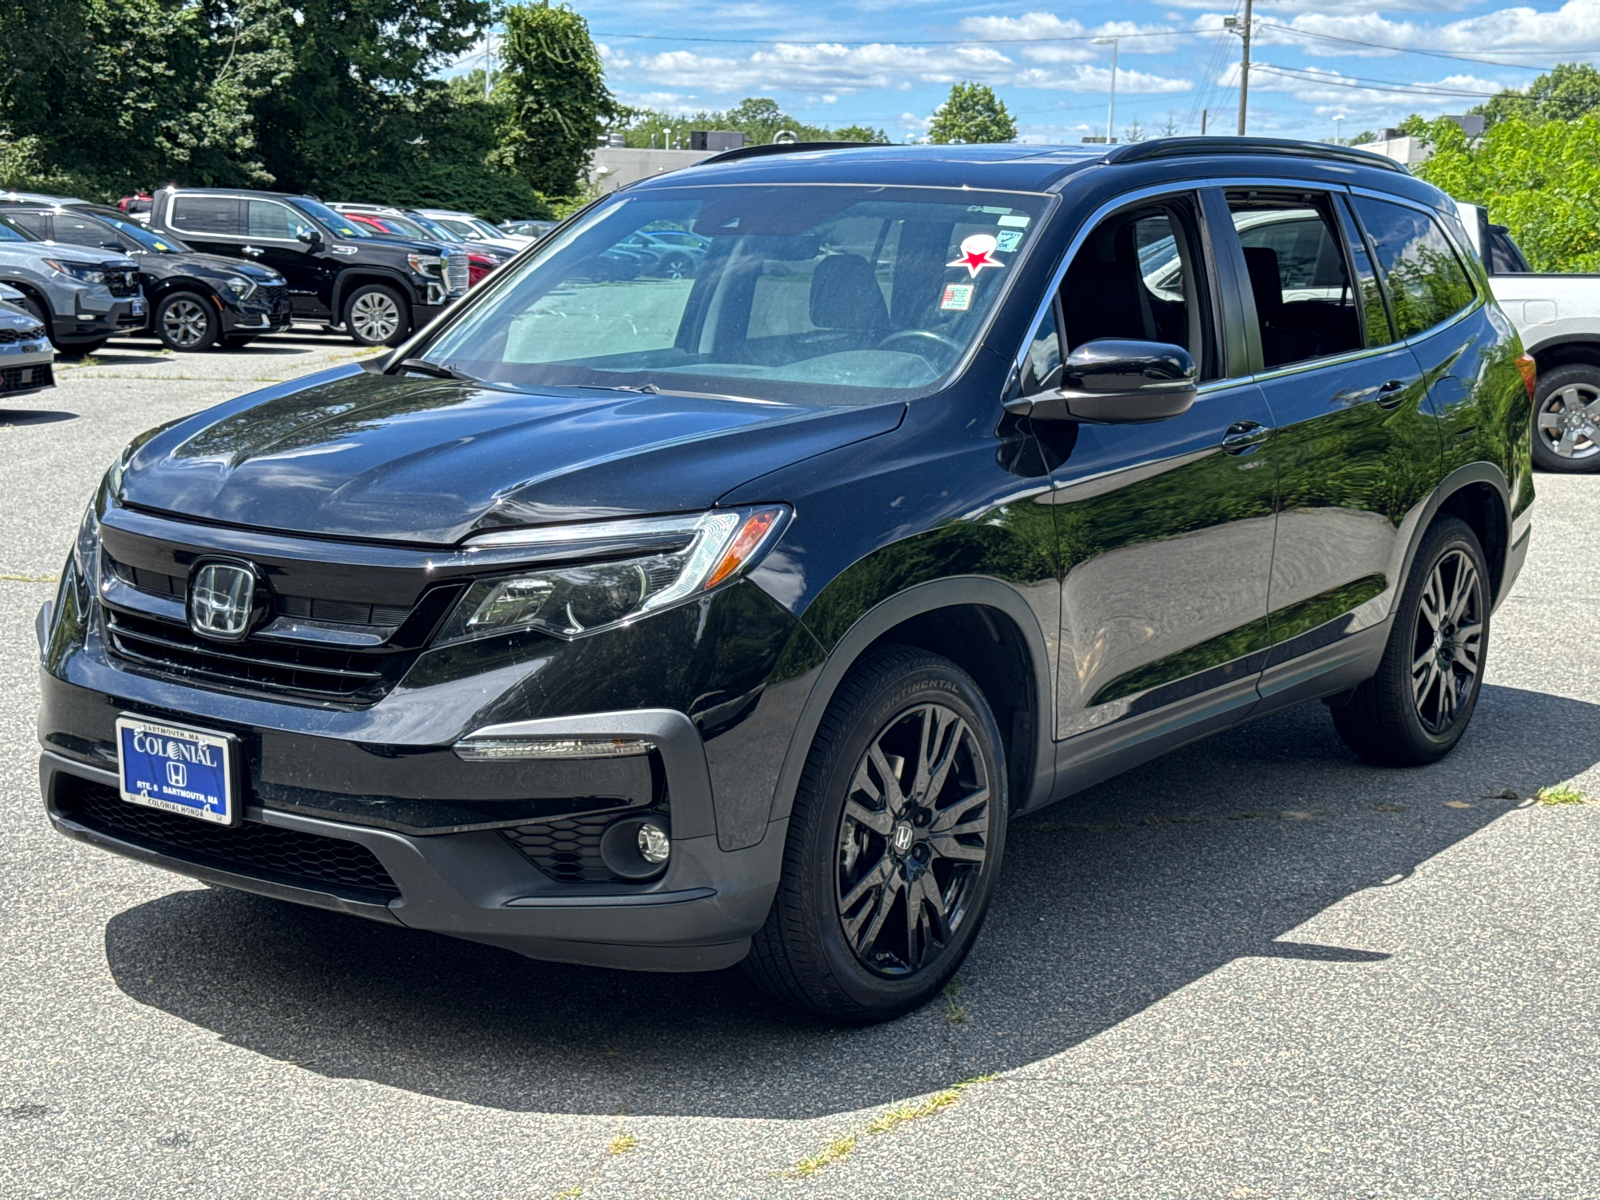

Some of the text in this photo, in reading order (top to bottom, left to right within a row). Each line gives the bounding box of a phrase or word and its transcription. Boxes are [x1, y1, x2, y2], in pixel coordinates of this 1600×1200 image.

[873, 680, 960, 724] CONTINENTAL
[133, 734, 217, 767] COLONIAL
[147, 798, 205, 818] COLONIAL HONDA
[153, 784, 159, 792] 6
[162, 787, 206, 803] DARTMOUTH,
[208, 796, 219, 805] MA
